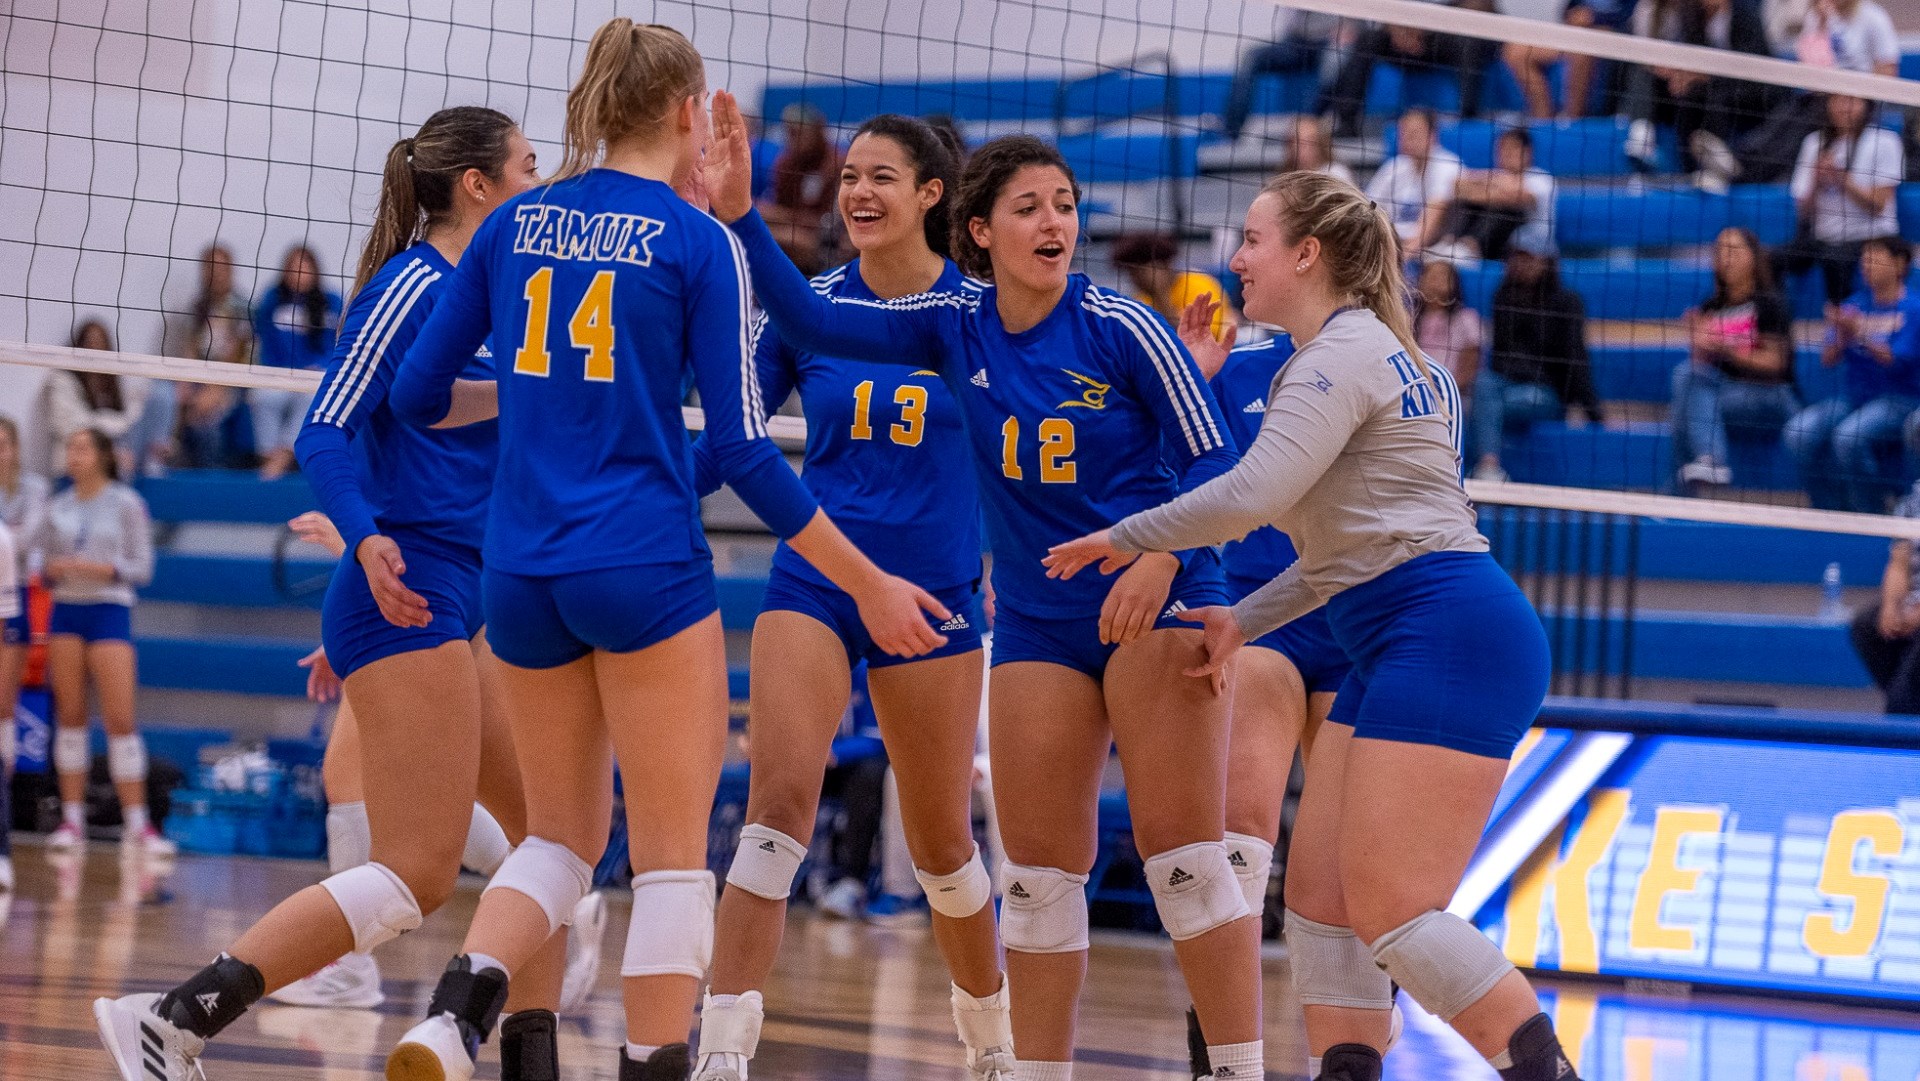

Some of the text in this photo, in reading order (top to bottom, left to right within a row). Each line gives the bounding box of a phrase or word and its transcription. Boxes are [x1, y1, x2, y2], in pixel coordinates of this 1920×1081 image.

[513, 204, 665, 267] TAMUK
[513, 266, 616, 382] 14
[851, 380, 929, 447] 13
[1001, 415, 1077, 483] 12
[940, 623, 970, 631] adidas
